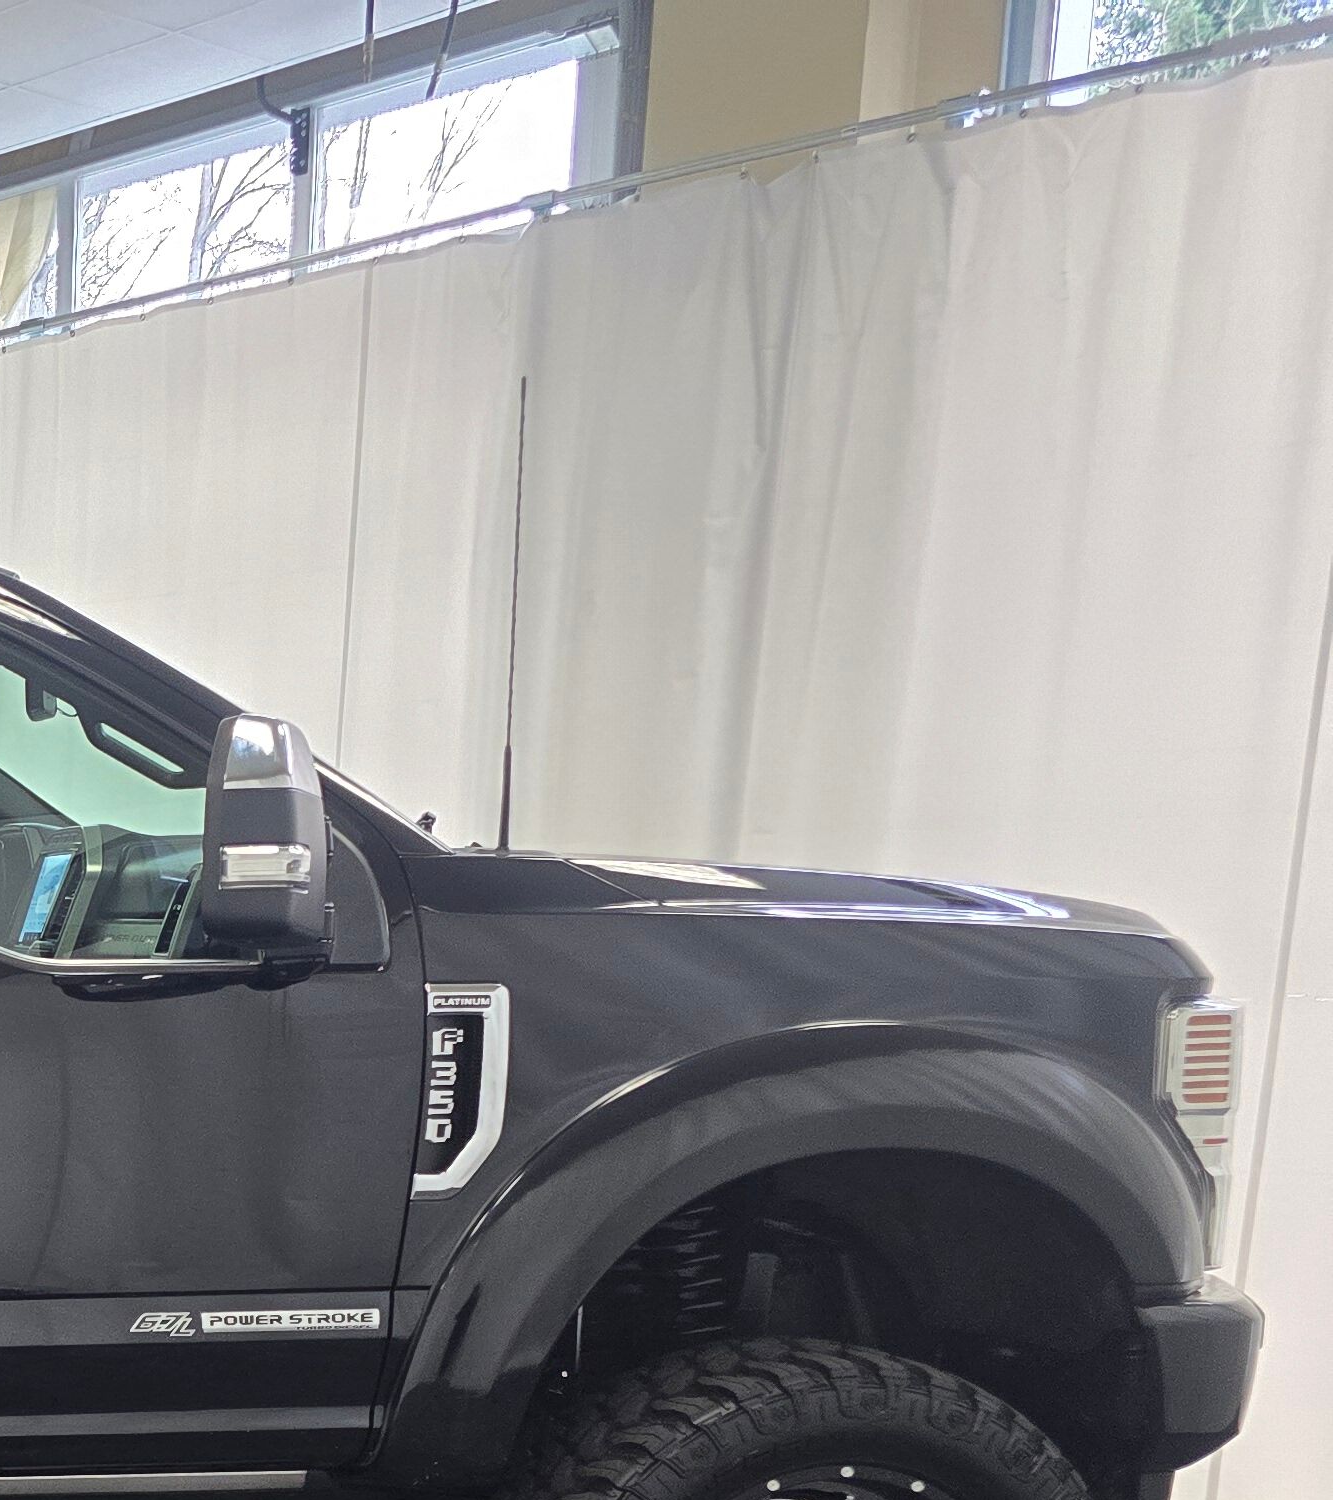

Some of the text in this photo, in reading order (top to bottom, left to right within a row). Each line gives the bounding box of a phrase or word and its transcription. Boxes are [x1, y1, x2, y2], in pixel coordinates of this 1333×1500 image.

[433, 997, 491, 1006] PLATINUM
[425, 1028, 464, 1143] F350
[209, 1314, 283, 1327] POWER
[288, 1312, 374, 1325] STROKE
